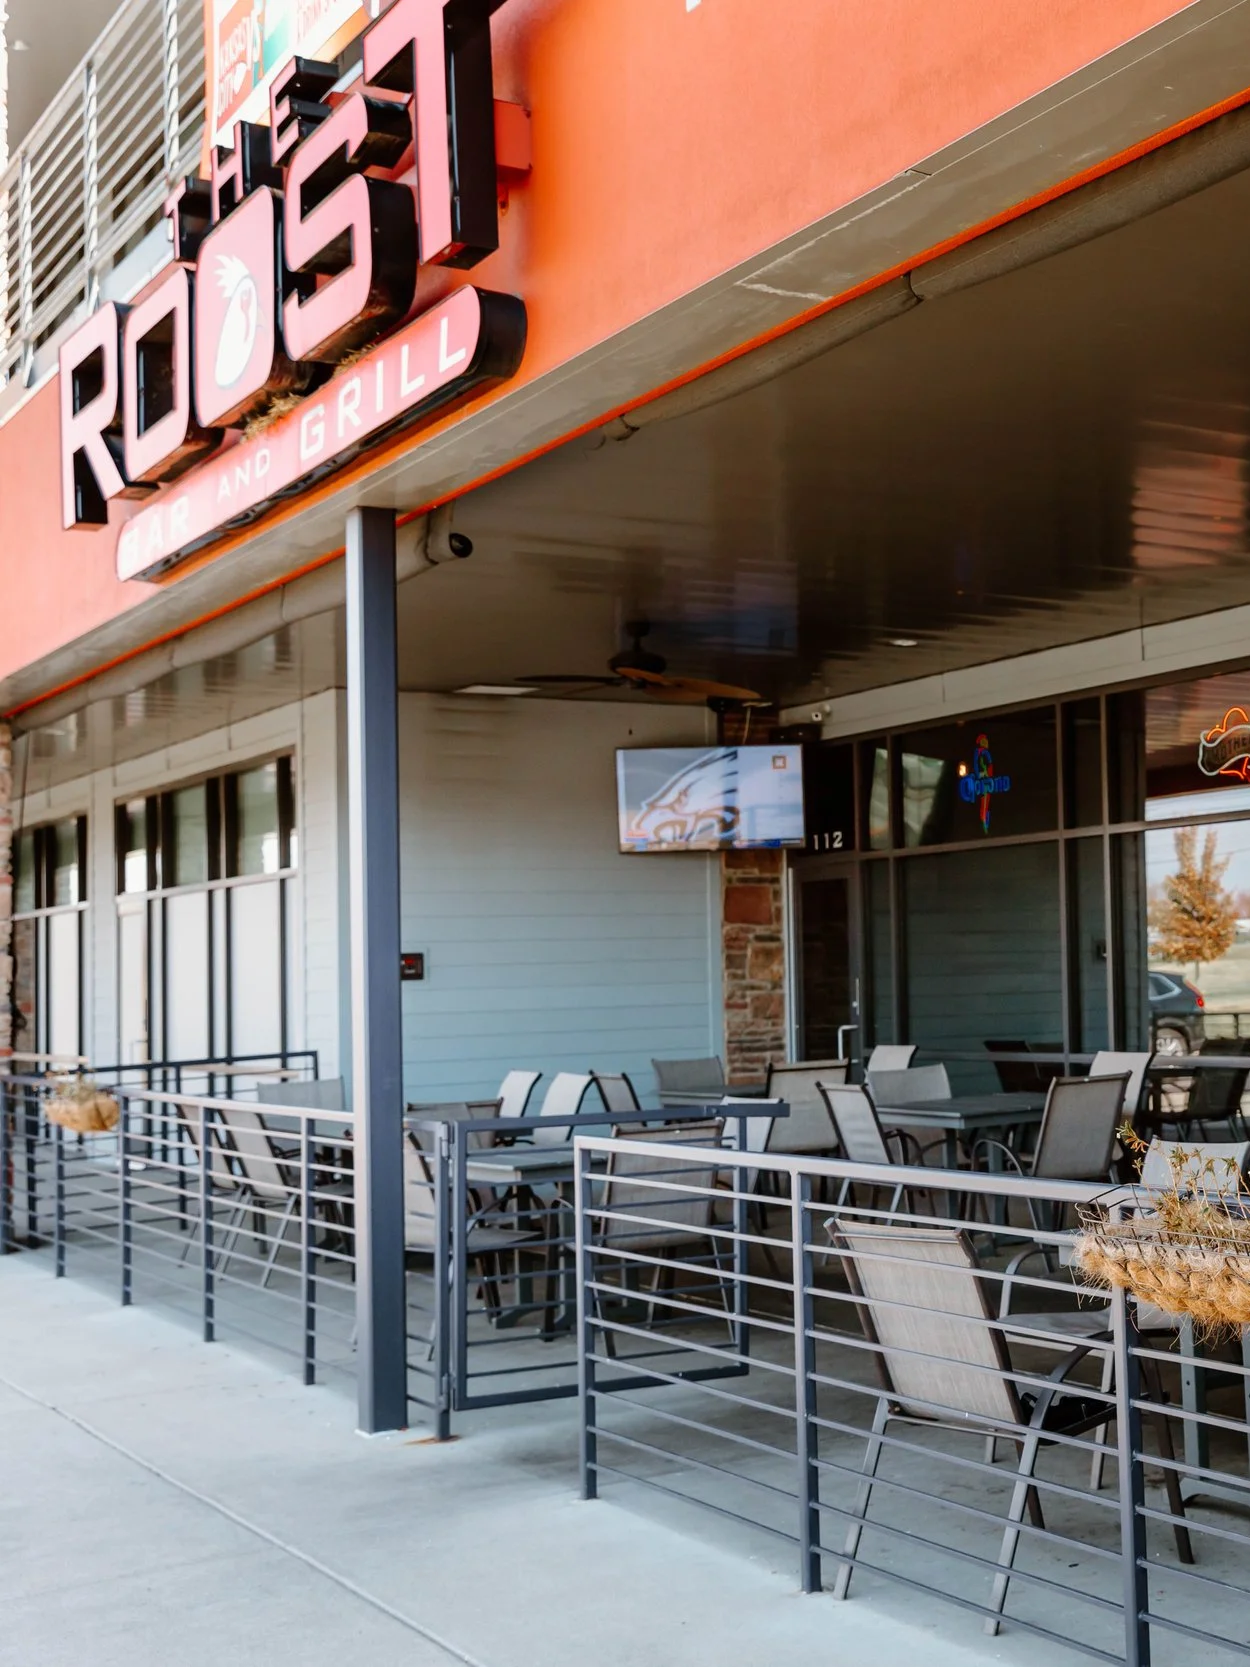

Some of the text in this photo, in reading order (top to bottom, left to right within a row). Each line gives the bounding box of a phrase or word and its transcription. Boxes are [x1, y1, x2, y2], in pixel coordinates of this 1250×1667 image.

[59, 0, 475, 530] ROOST
[165, 56, 298, 259] THE
[123, 317, 466, 562] BAR AND GRILL
[813, 831, 843, 850] 112
